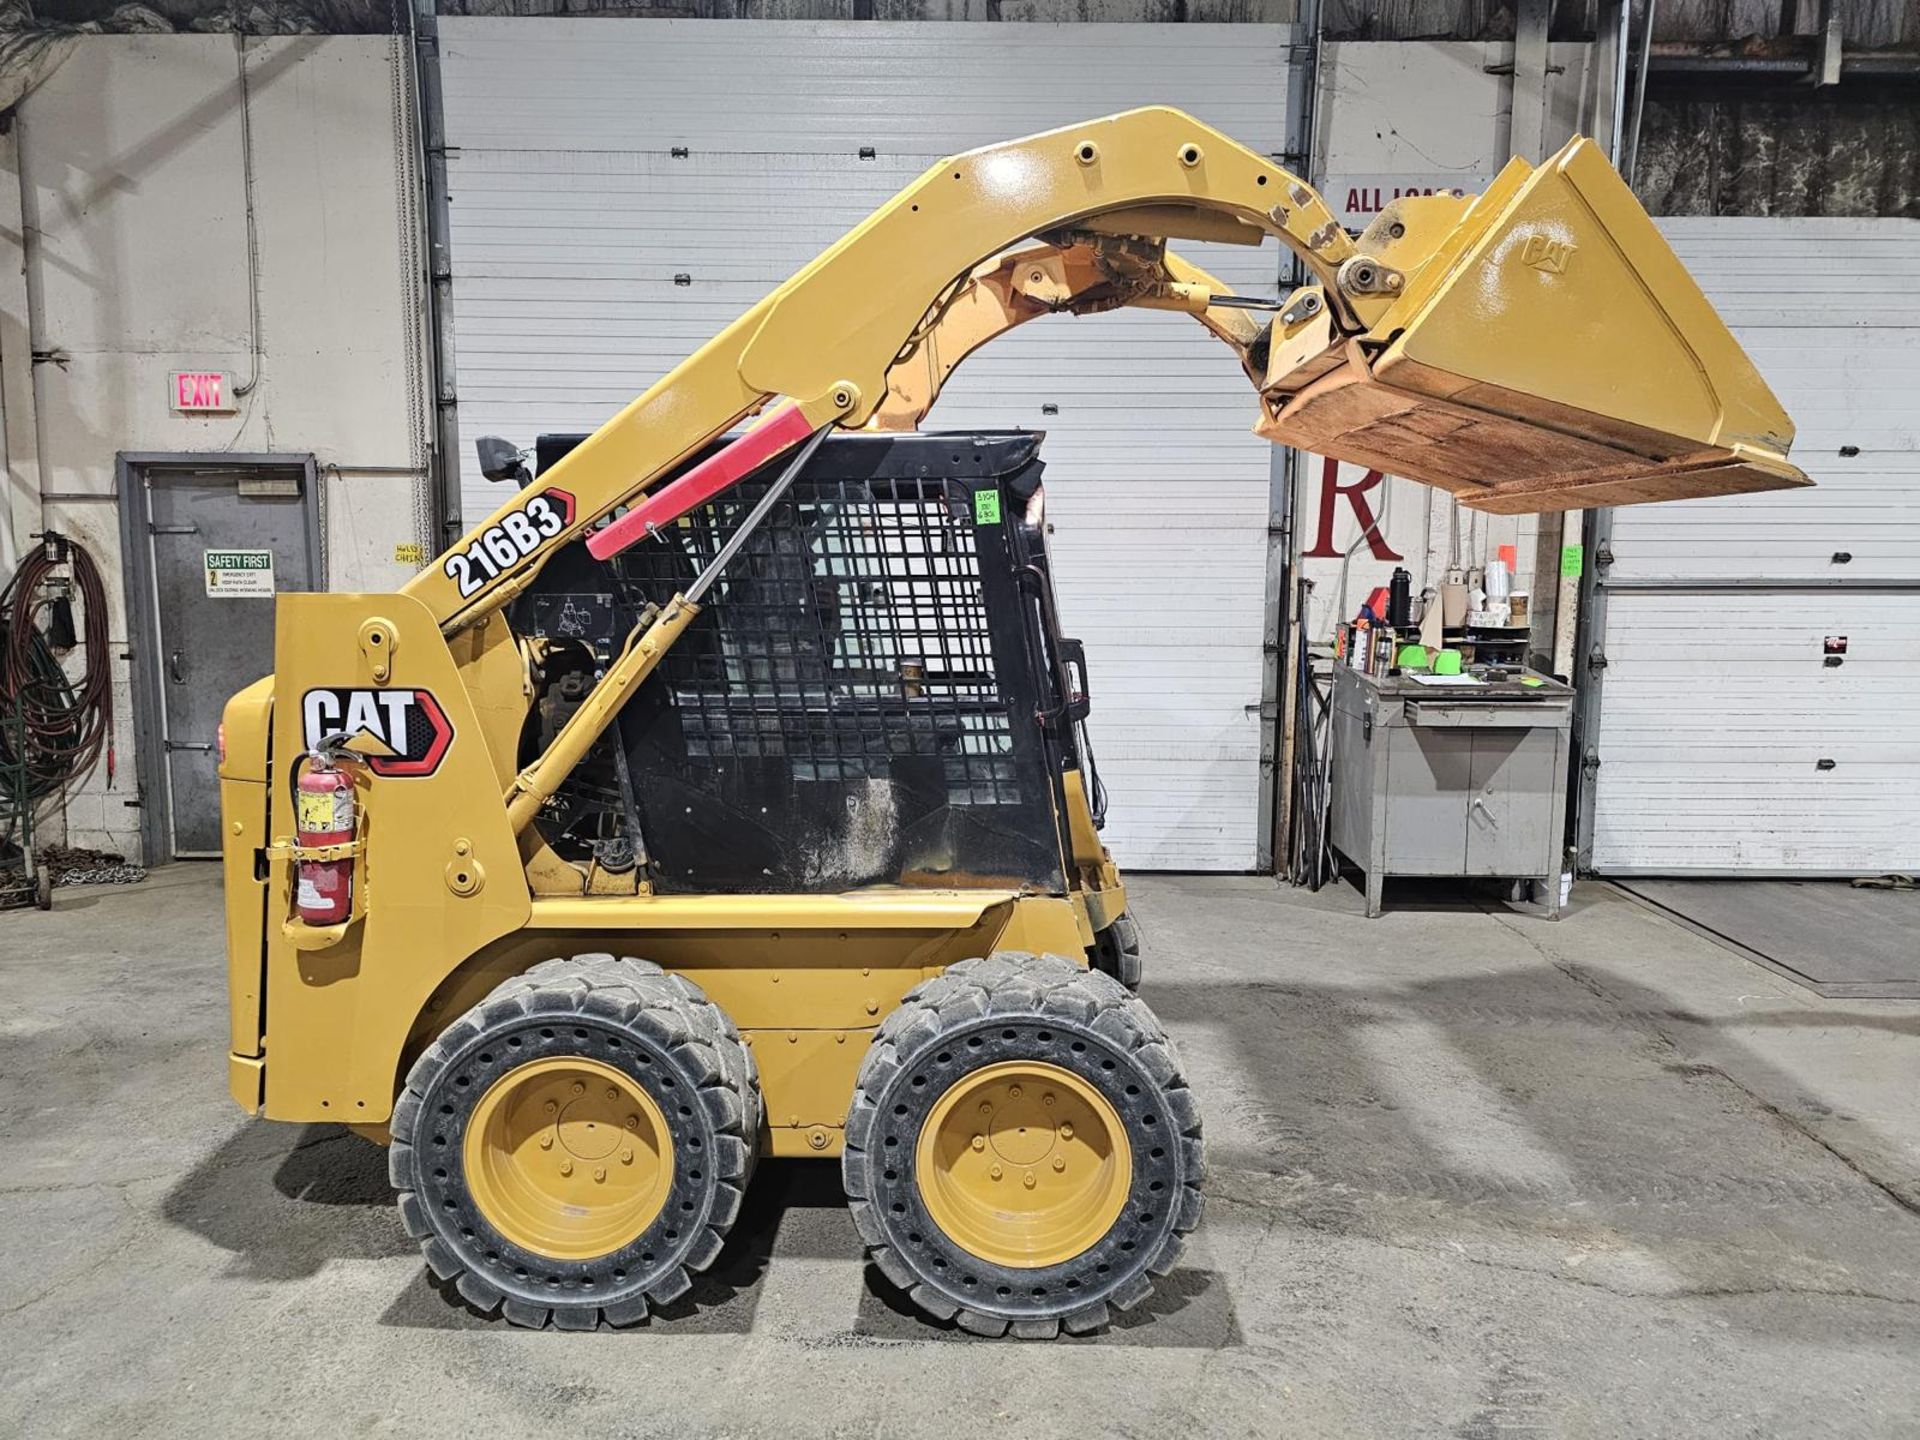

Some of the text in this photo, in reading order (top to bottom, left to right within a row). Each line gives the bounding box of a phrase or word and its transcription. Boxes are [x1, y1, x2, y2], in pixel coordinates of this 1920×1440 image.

[1345, 188, 1384, 212] ALL
[1521, 234, 1578, 275] CAT
[178, 375, 222, 406] EXIT
[208, 555, 268, 568] SAFETY FIRST
[445, 497, 562, 599] 216B3
[304, 690, 415, 756] CAT
